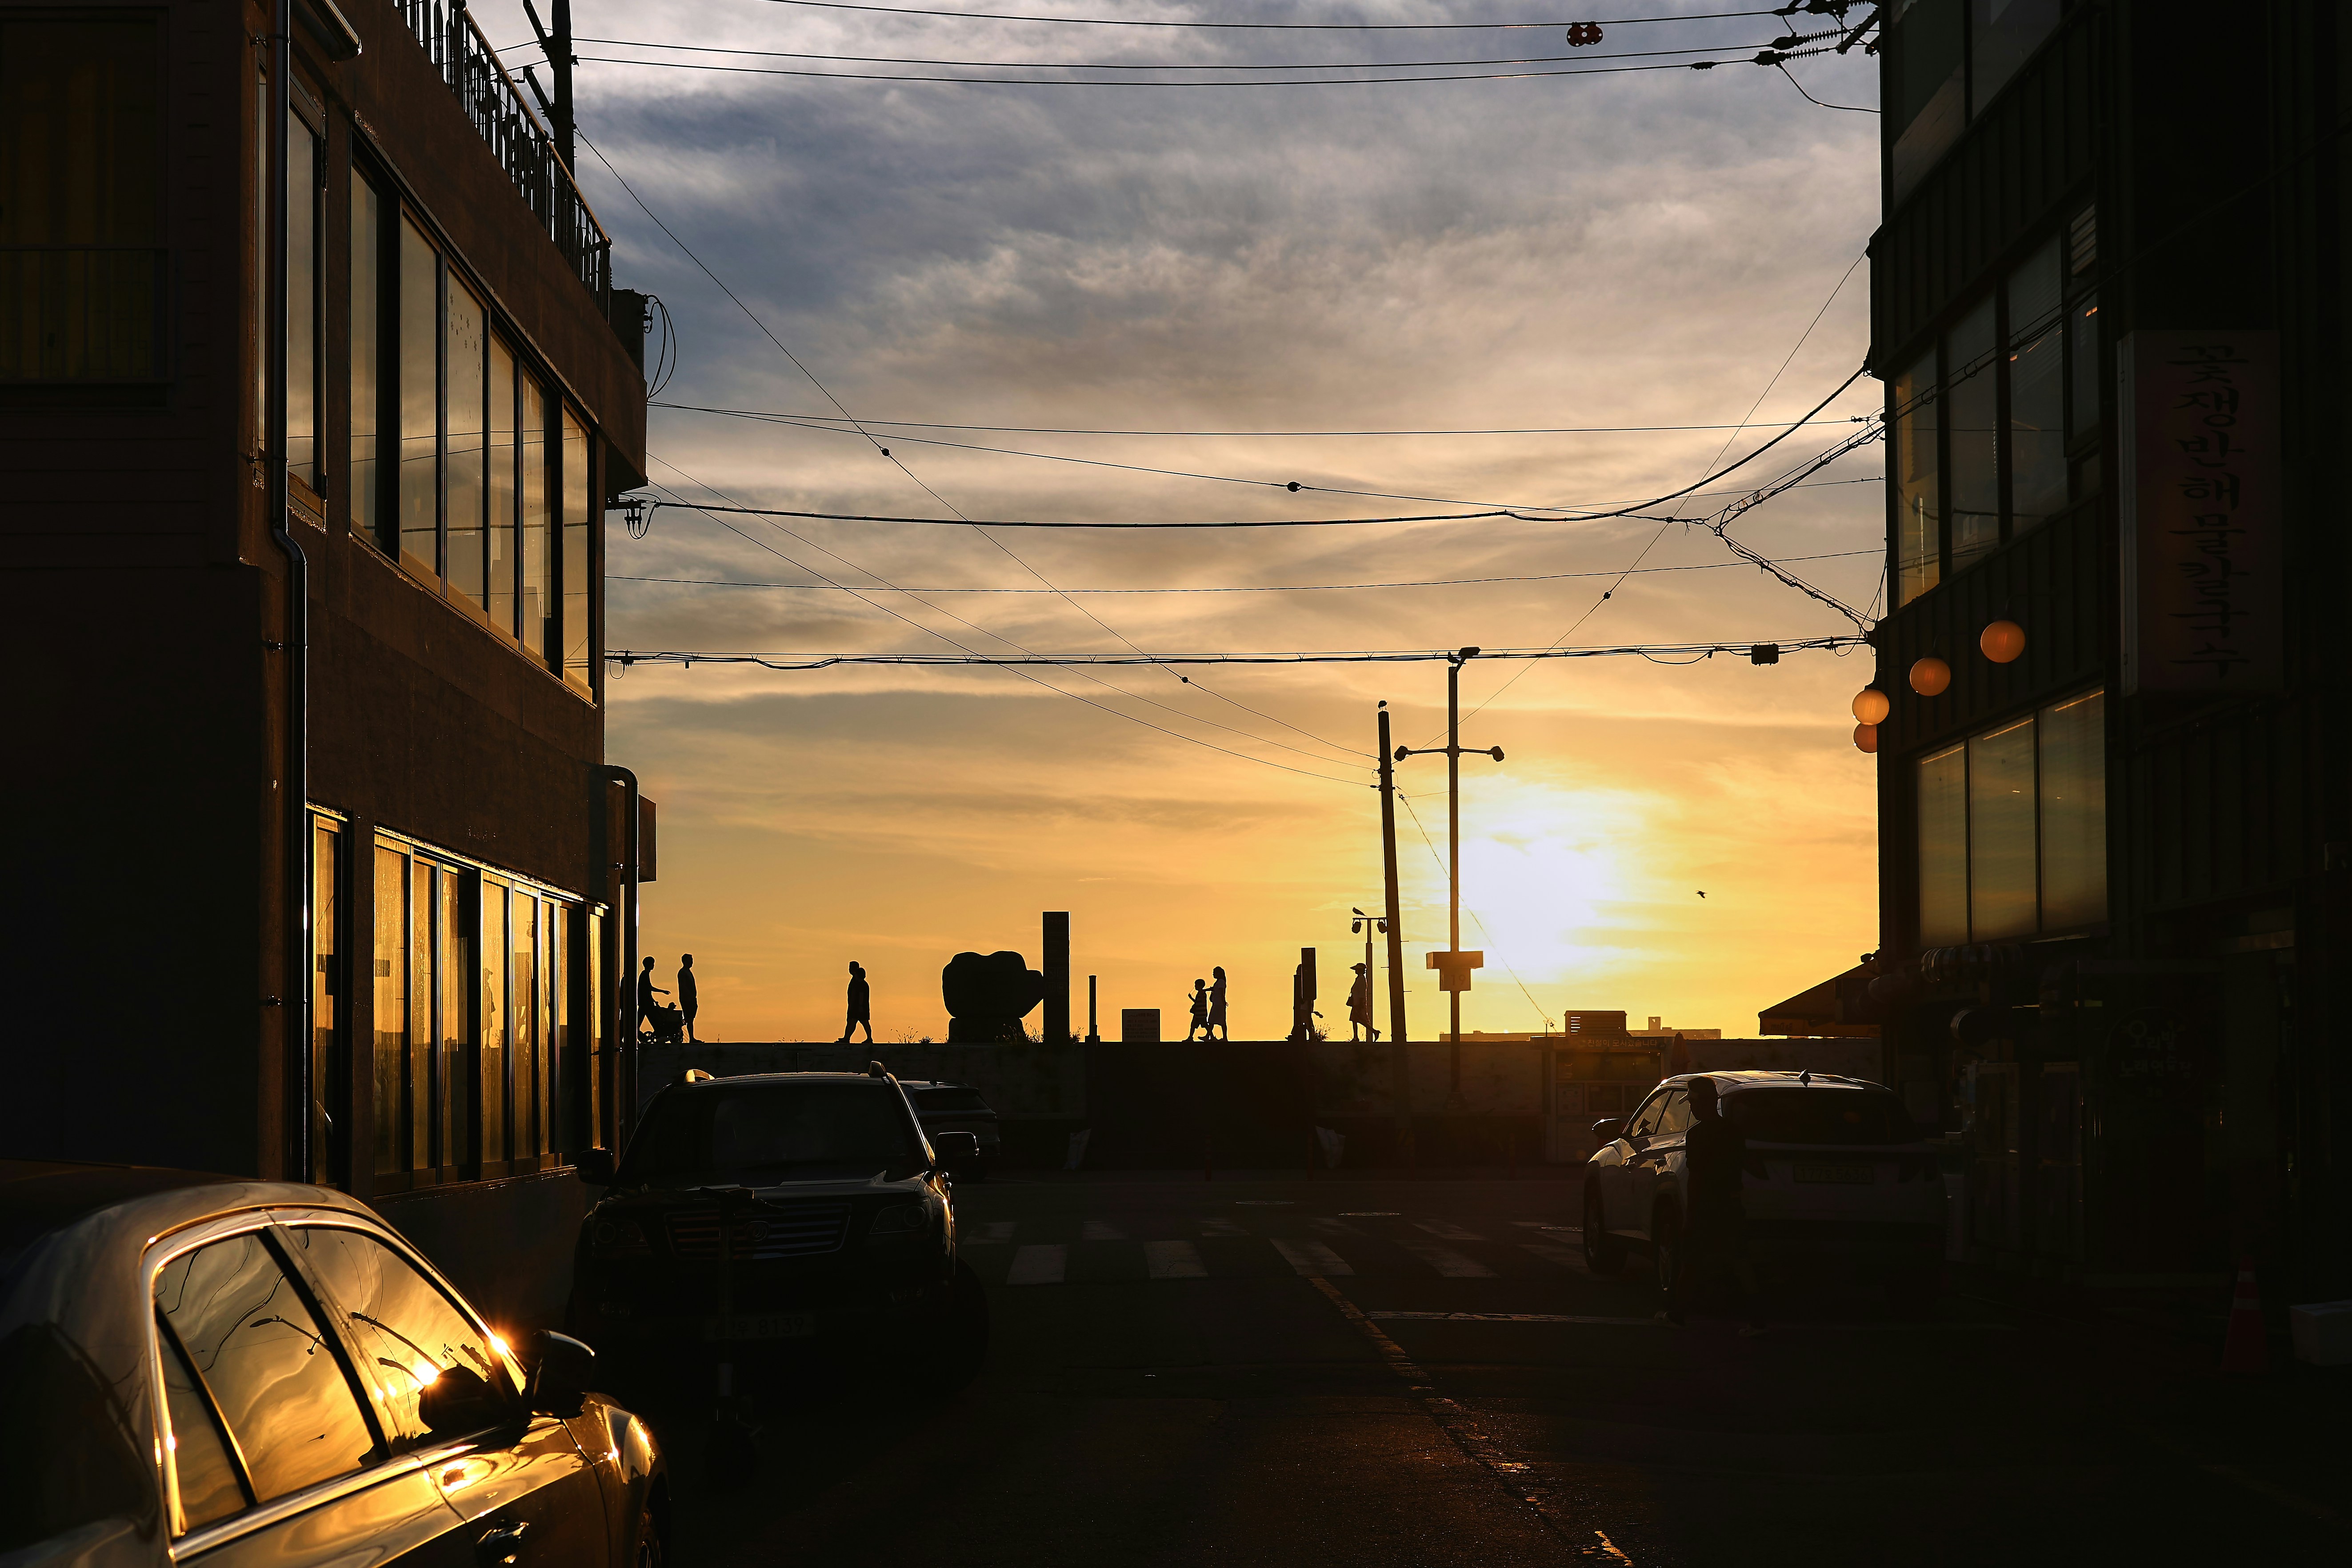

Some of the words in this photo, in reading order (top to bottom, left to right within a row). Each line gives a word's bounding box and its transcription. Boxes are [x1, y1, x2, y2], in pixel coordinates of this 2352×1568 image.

[2165, 345, 2251, 678] 꽃쟁반해물칼국수
[1451, 974, 1465, 986] 19
[1612, 1039, 1658, 1047] 모시겠습니다
[2128, 1020, 2177, 1052] 오리발
[2119, 1053, 2193, 1078] 노래연습장
[758, 1317, 804, 1335] 8139
